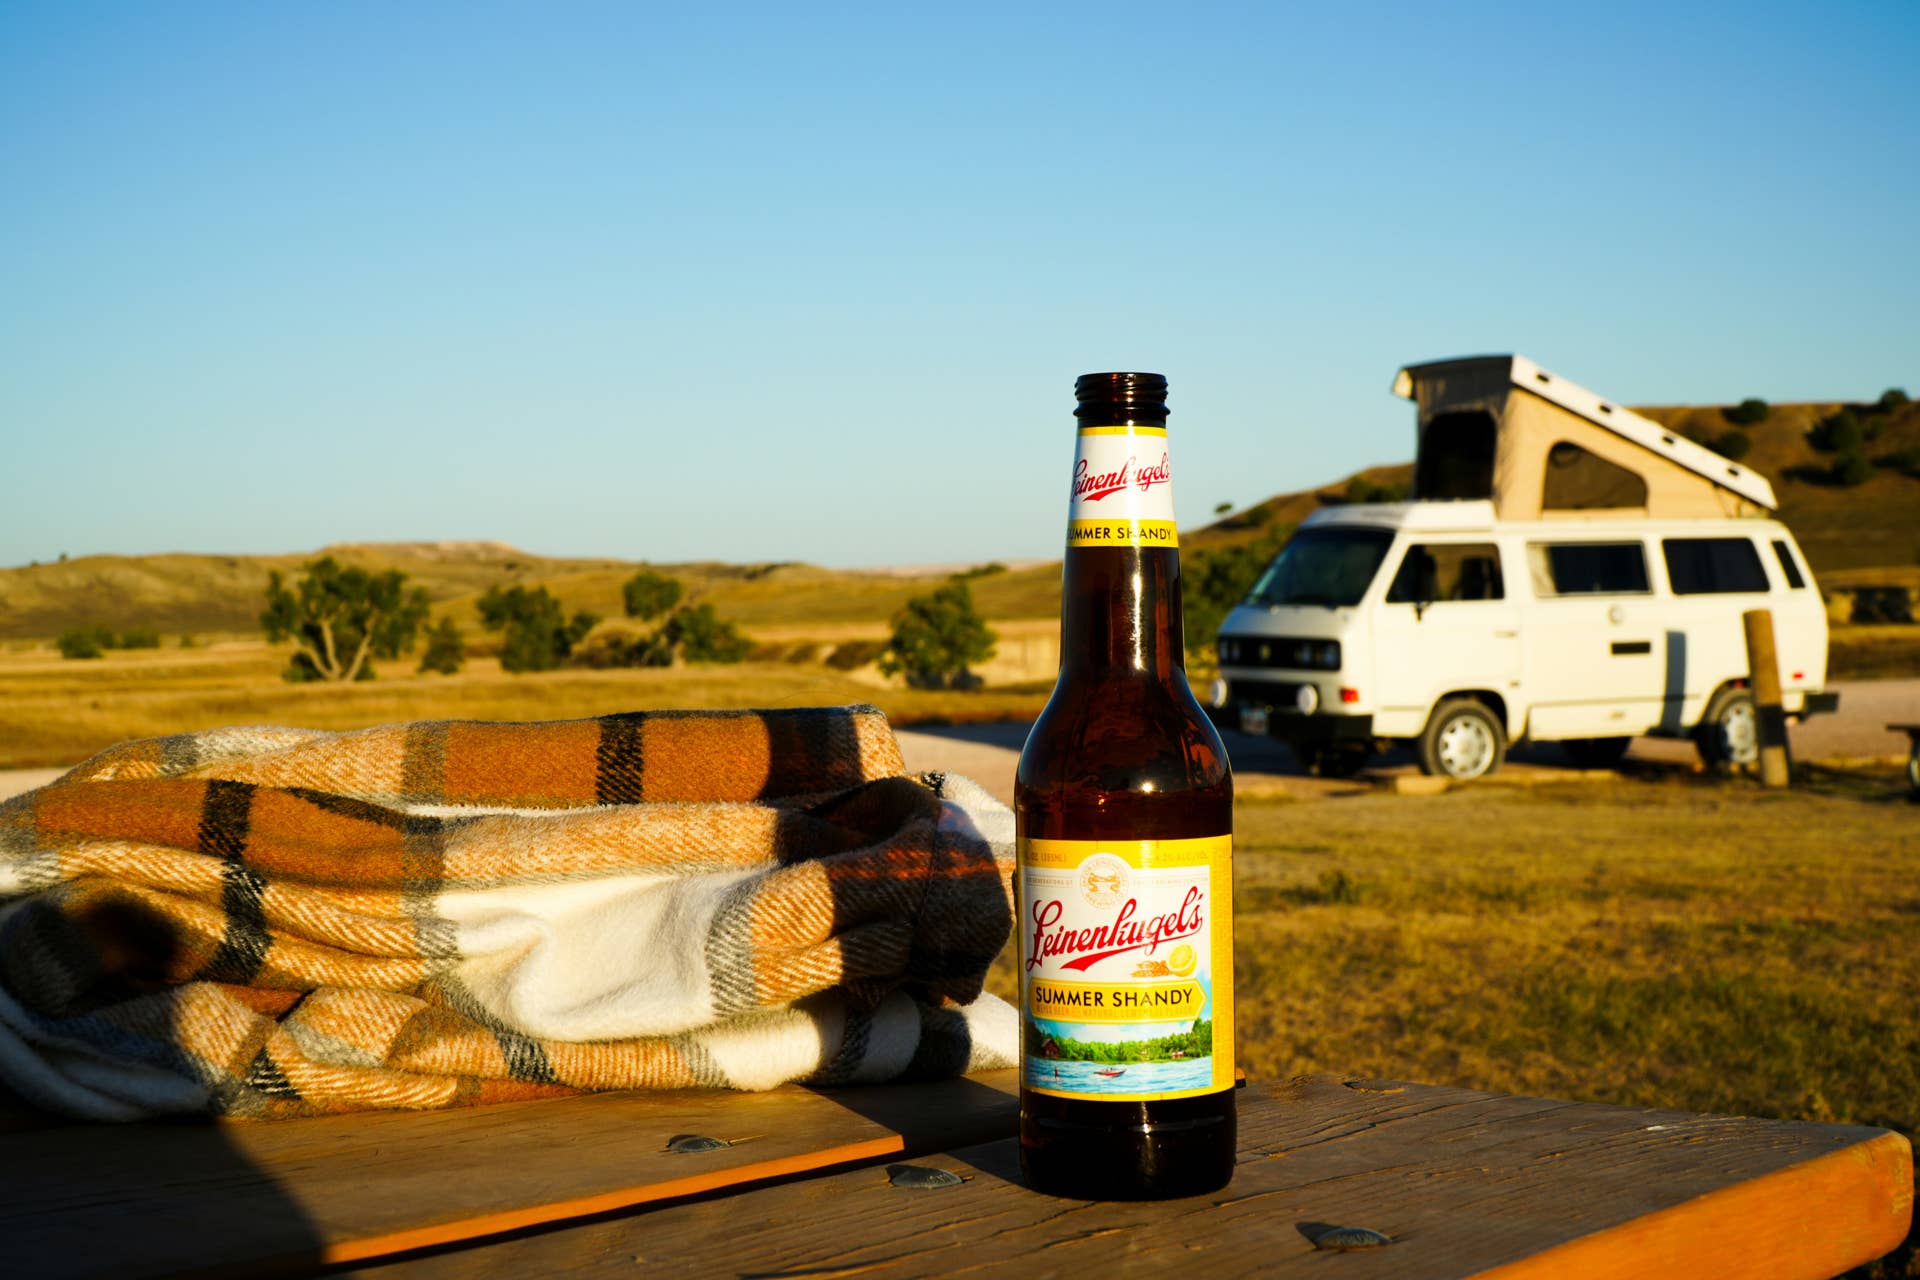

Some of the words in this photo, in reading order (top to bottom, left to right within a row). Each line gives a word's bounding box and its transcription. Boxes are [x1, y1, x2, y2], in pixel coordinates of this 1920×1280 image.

[1028, 885, 1204, 971] Leinenkugel's
[1035, 986, 1104, 1007] SUMMER
[1112, 988, 1193, 1007] SHANDY
